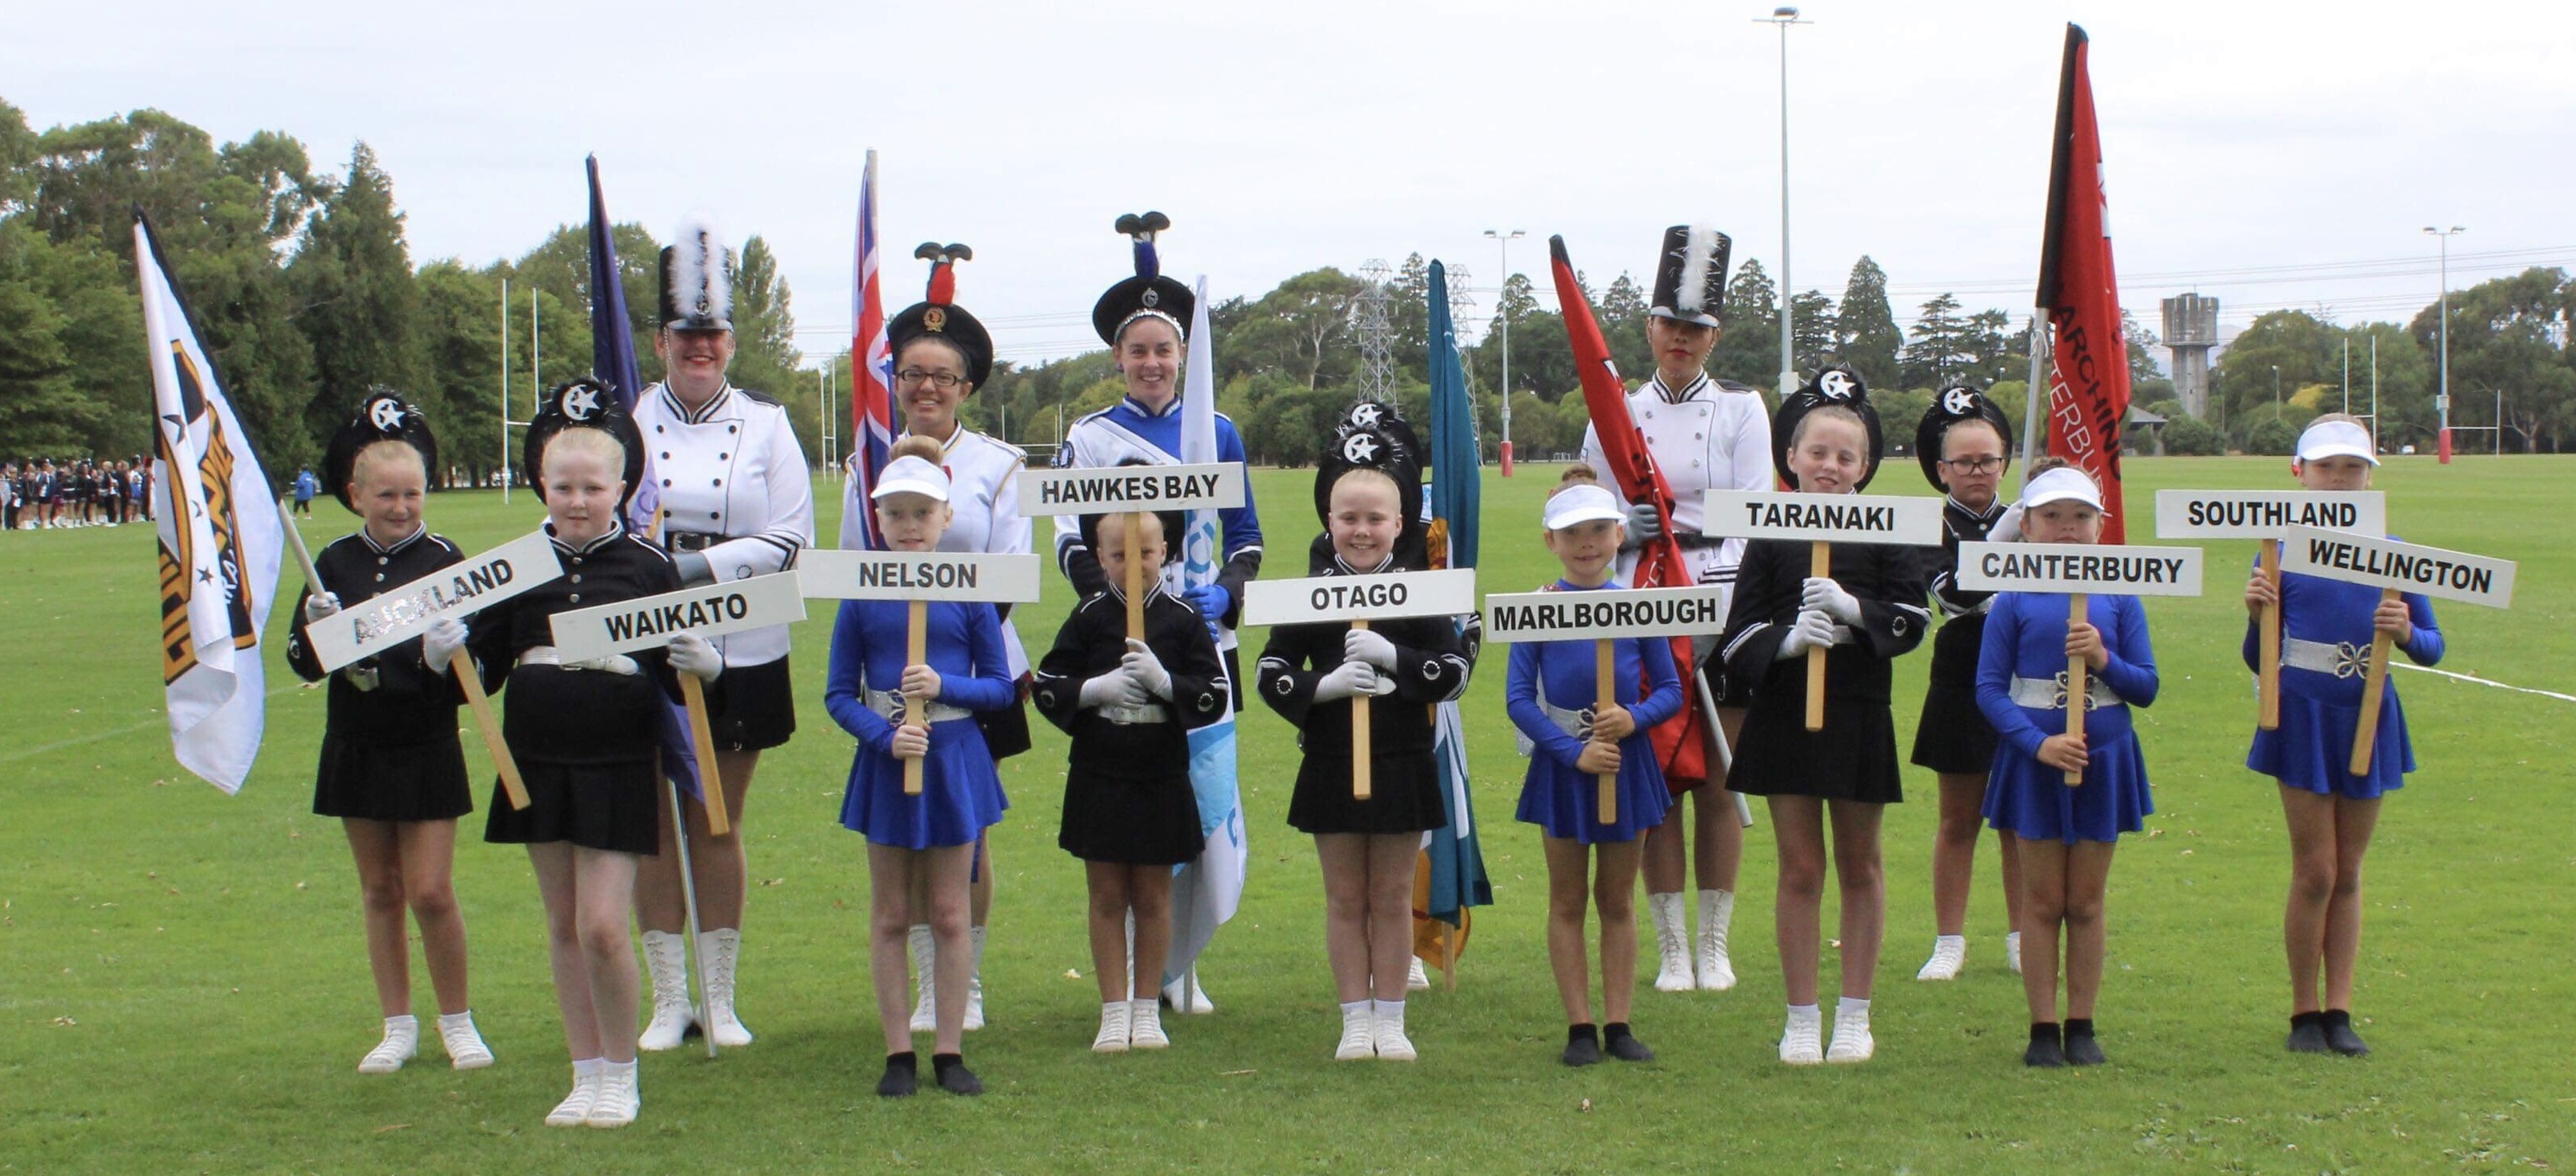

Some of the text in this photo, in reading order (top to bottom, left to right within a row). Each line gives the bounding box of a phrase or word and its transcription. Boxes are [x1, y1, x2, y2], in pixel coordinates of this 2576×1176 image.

[1042, 474, 1219, 504] HAWKES BAY
[1745, 502, 1894, 532] TARANAKI
[2188, 500, 2357, 527] SOUTHLAND
[859, 562, 977, 589] NELSON
[1982, 553, 2185, 584] CANTERBURY
[2309, 538, 2492, 594] WELLINGTON
[354, 558, 514, 644] AUCKLAND
[1310, 582, 1408, 610] OTAGO
[604, 593, 748, 642] WAIKATO
[1494, 598, 1717, 631] MARLBOROUGH
